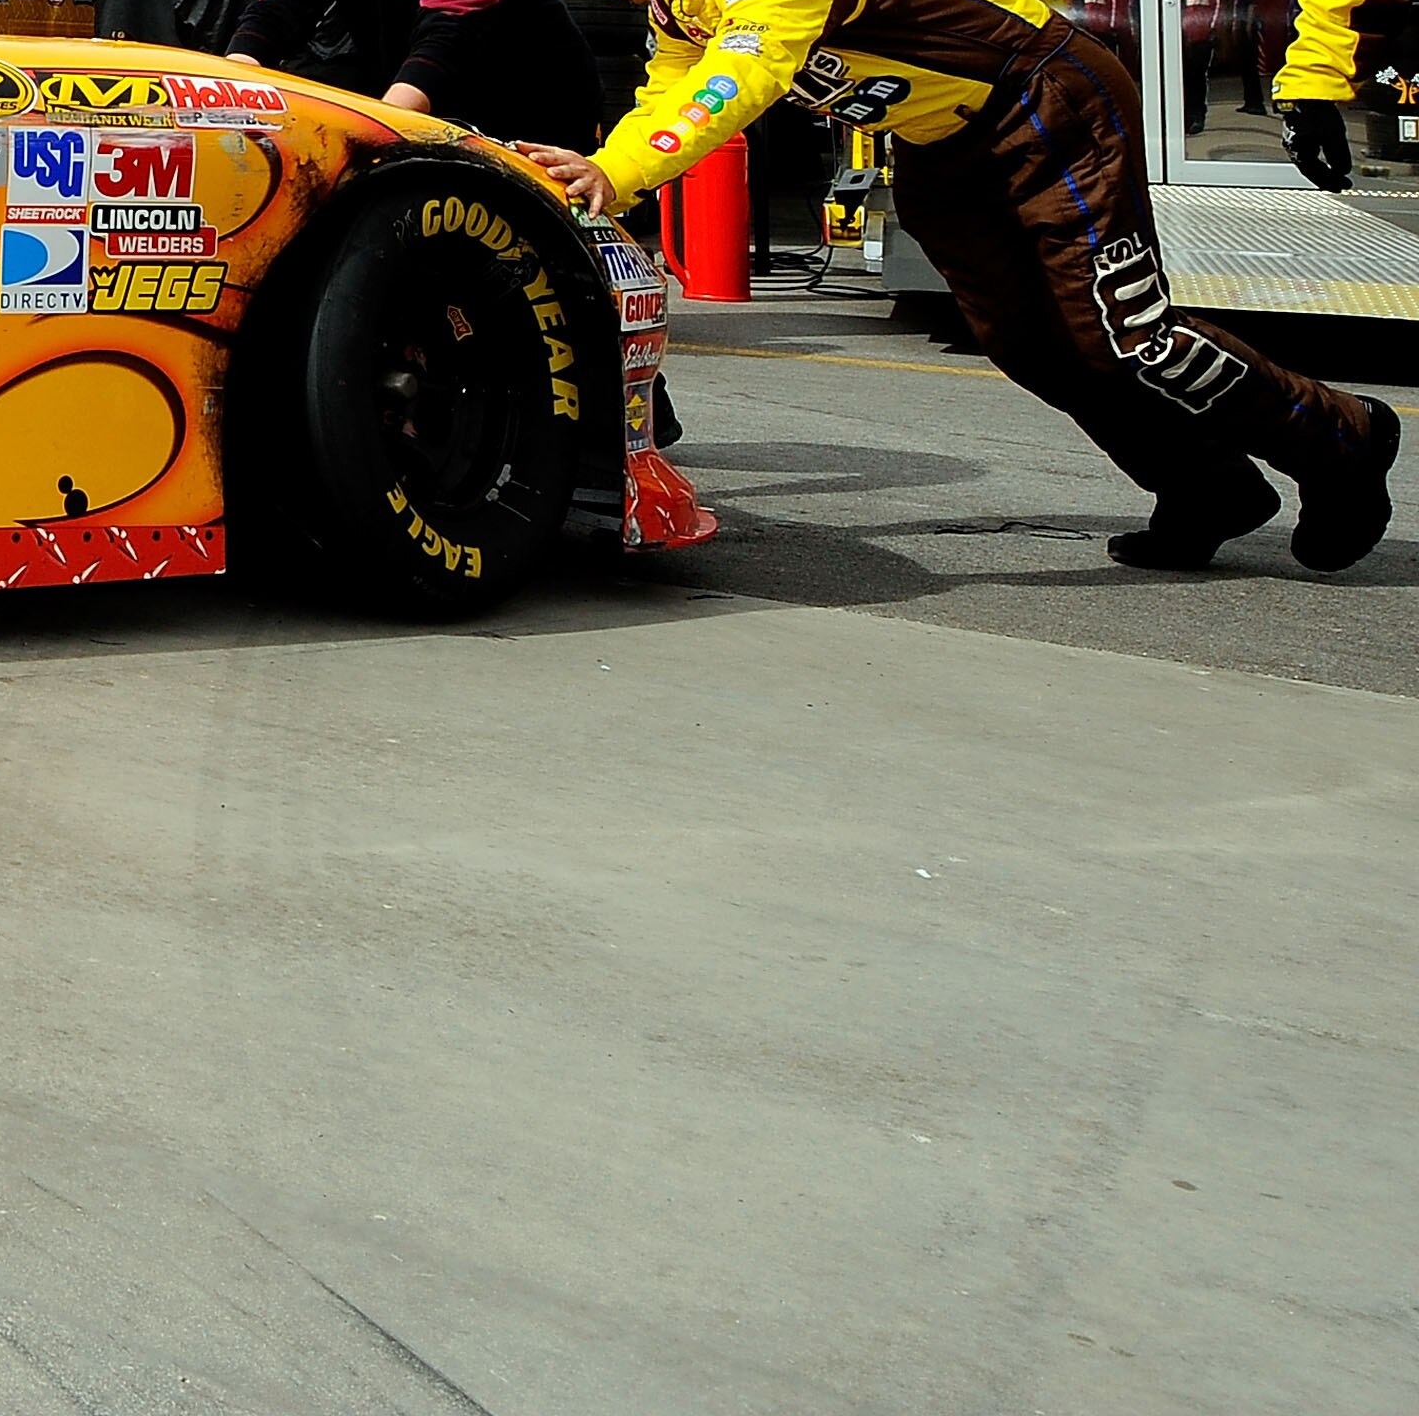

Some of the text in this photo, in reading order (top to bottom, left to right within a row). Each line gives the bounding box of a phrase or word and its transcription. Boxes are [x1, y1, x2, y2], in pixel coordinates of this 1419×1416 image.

[170, 76, 285, 112] Holley
[12, 130, 84, 198] USG
[94, 141, 194, 199] 3M
[7, 207, 84, 221] SHEETROCK
[96, 208, 196, 231] LINCOLN
[118, 235, 204, 254] WELDERS
[0, 292, 84, 310] DIRECTV
[92, 264, 227, 312] JEGS
[386, 481, 482, 579] EAGLE
